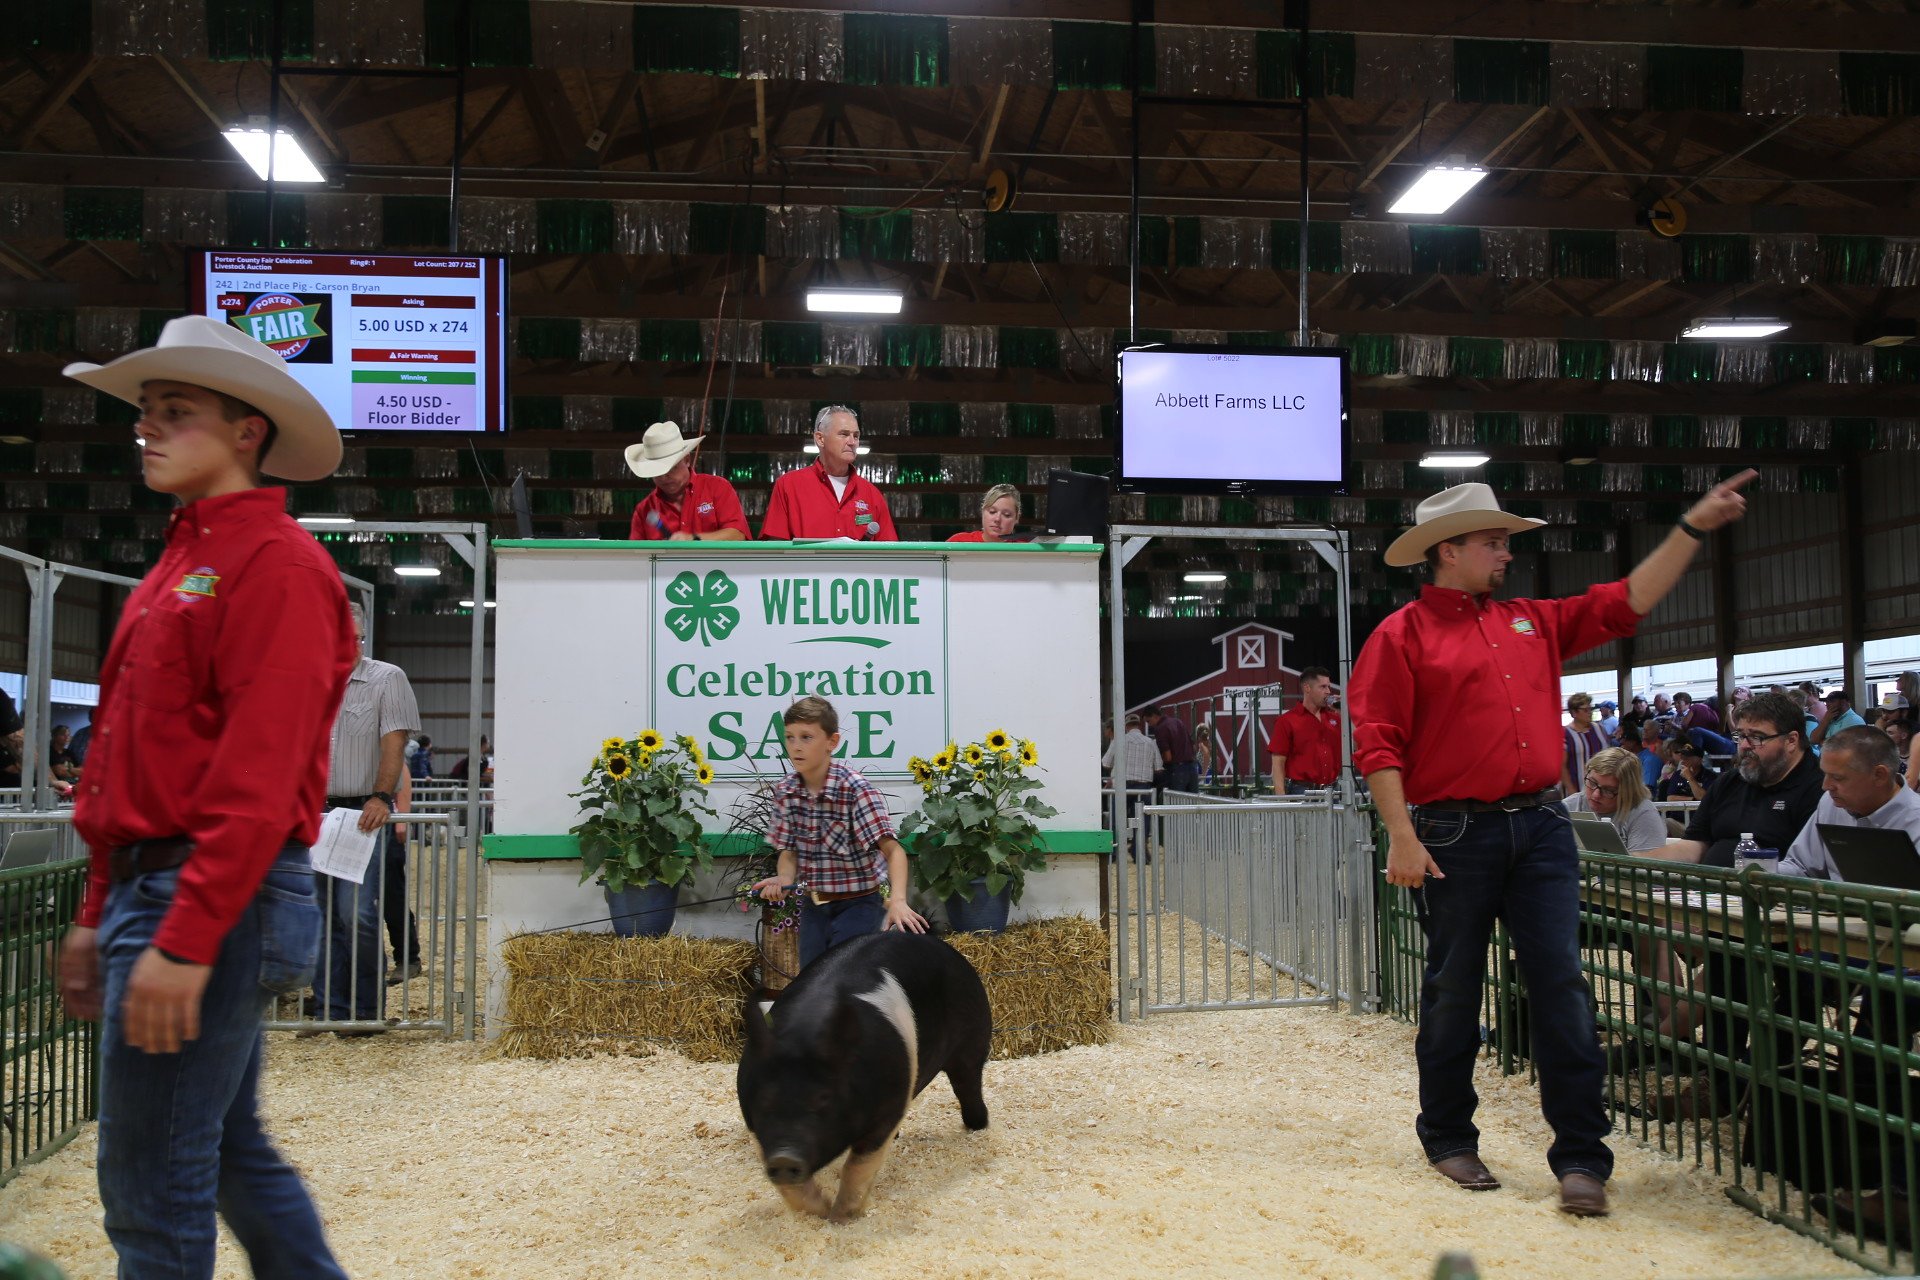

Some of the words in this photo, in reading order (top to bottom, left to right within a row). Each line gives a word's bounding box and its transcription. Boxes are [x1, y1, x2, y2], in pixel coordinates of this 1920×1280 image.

[237, 257, 260, 265] County
[350, 259, 371, 267] Ring#:
[216, 281, 232, 289] 242
[243, 281, 261, 289] 2nd
[264, 281, 289, 290] Place
[292, 282, 307, 292] Pig
[315, 282, 349, 291] Carson
[352, 283, 380, 293] Bryan
[221, 298, 241, 306] x274
[255, 296, 293, 310] PORTER
[402, 298, 425, 307] Asking
[250, 311, 308, 342] FAIR
[359, 319, 389, 332] 5.00
[394, 320, 424, 332] USD
[429, 323, 438, 332] x
[442, 321, 468, 333] 274
[411, 353, 438, 361] Warning
[400, 374, 428, 382] Winning
[376, 395, 407, 408] 4.50
[412, 396, 442, 408] USD
[1155, 392, 1209, 408] Abbett
[1215, 393, 1267, 410] Farms
[1273, 395, 1305, 410] LLC
[368, 411, 406, 424] Floor
[411, 412, 461, 425] Bidder
[760, 578, 920, 625] WELCOME
[666, 661, 935, 698] Celebration
[707, 710, 896, 761] SAE
